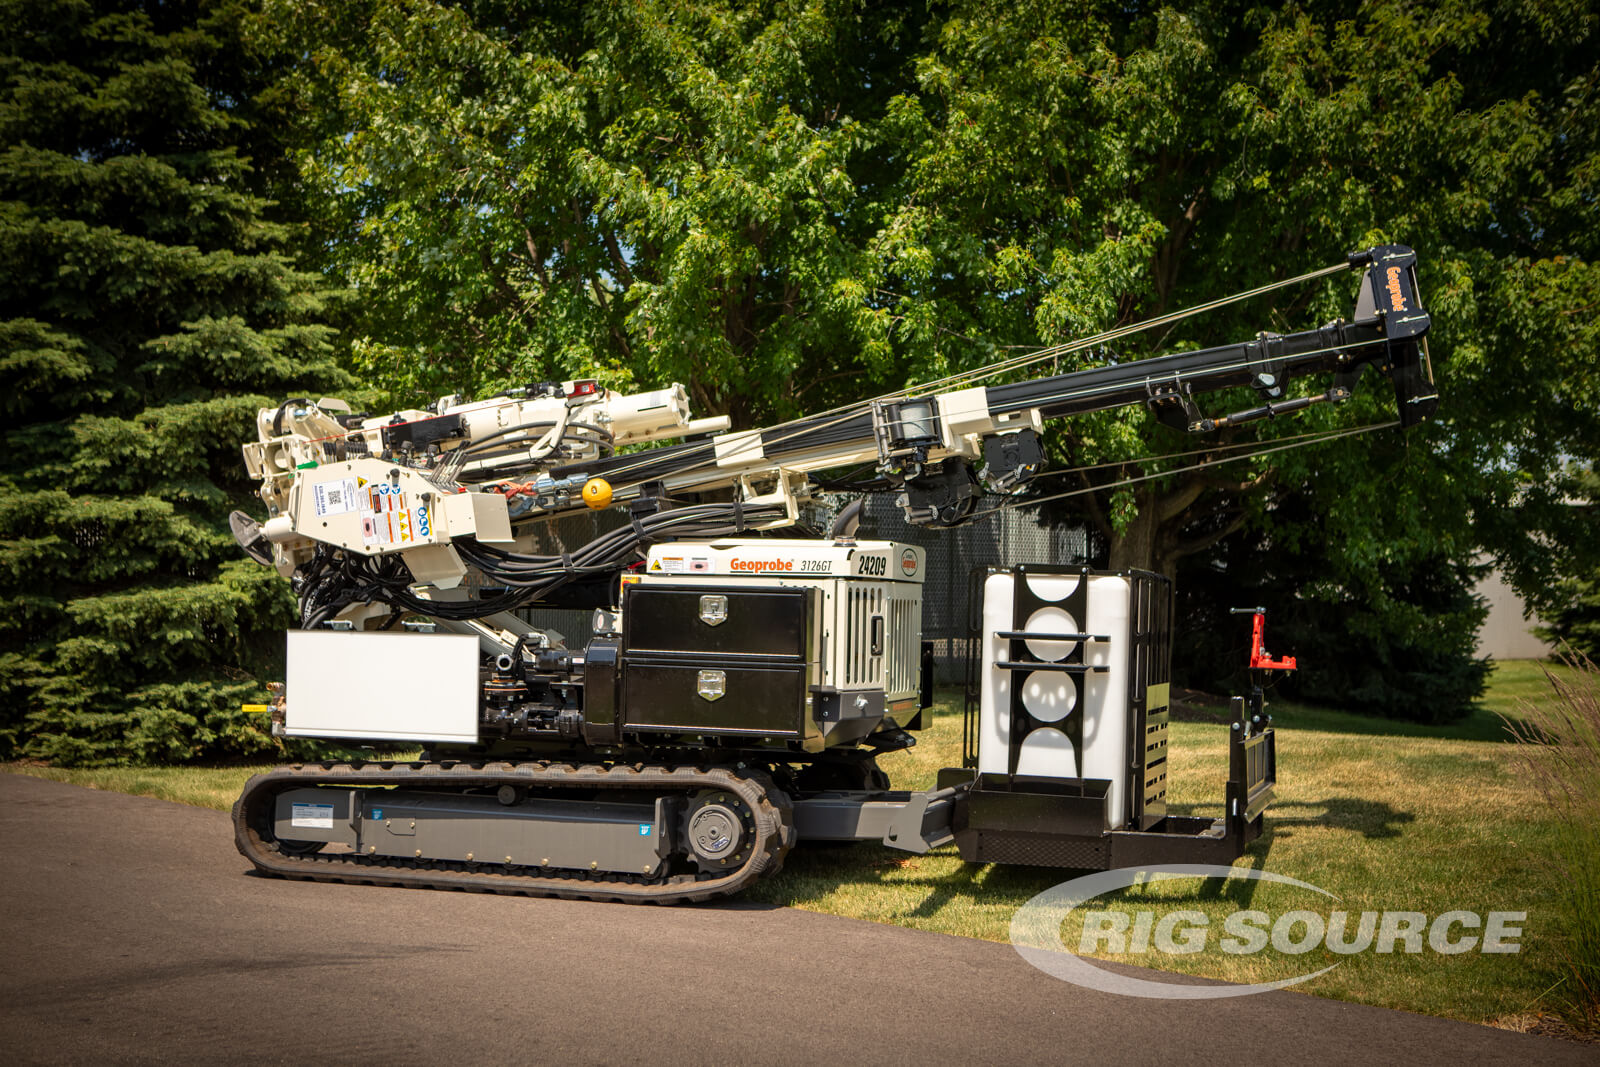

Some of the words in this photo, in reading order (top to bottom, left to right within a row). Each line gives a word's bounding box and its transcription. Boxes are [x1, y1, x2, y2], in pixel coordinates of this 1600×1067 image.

[1386, 266, 1406, 312] Geoprobe
[730, 557, 793, 573] Geoprobe
[800, 560, 832, 571] 3126GT
[858, 555, 887, 576] 24209
